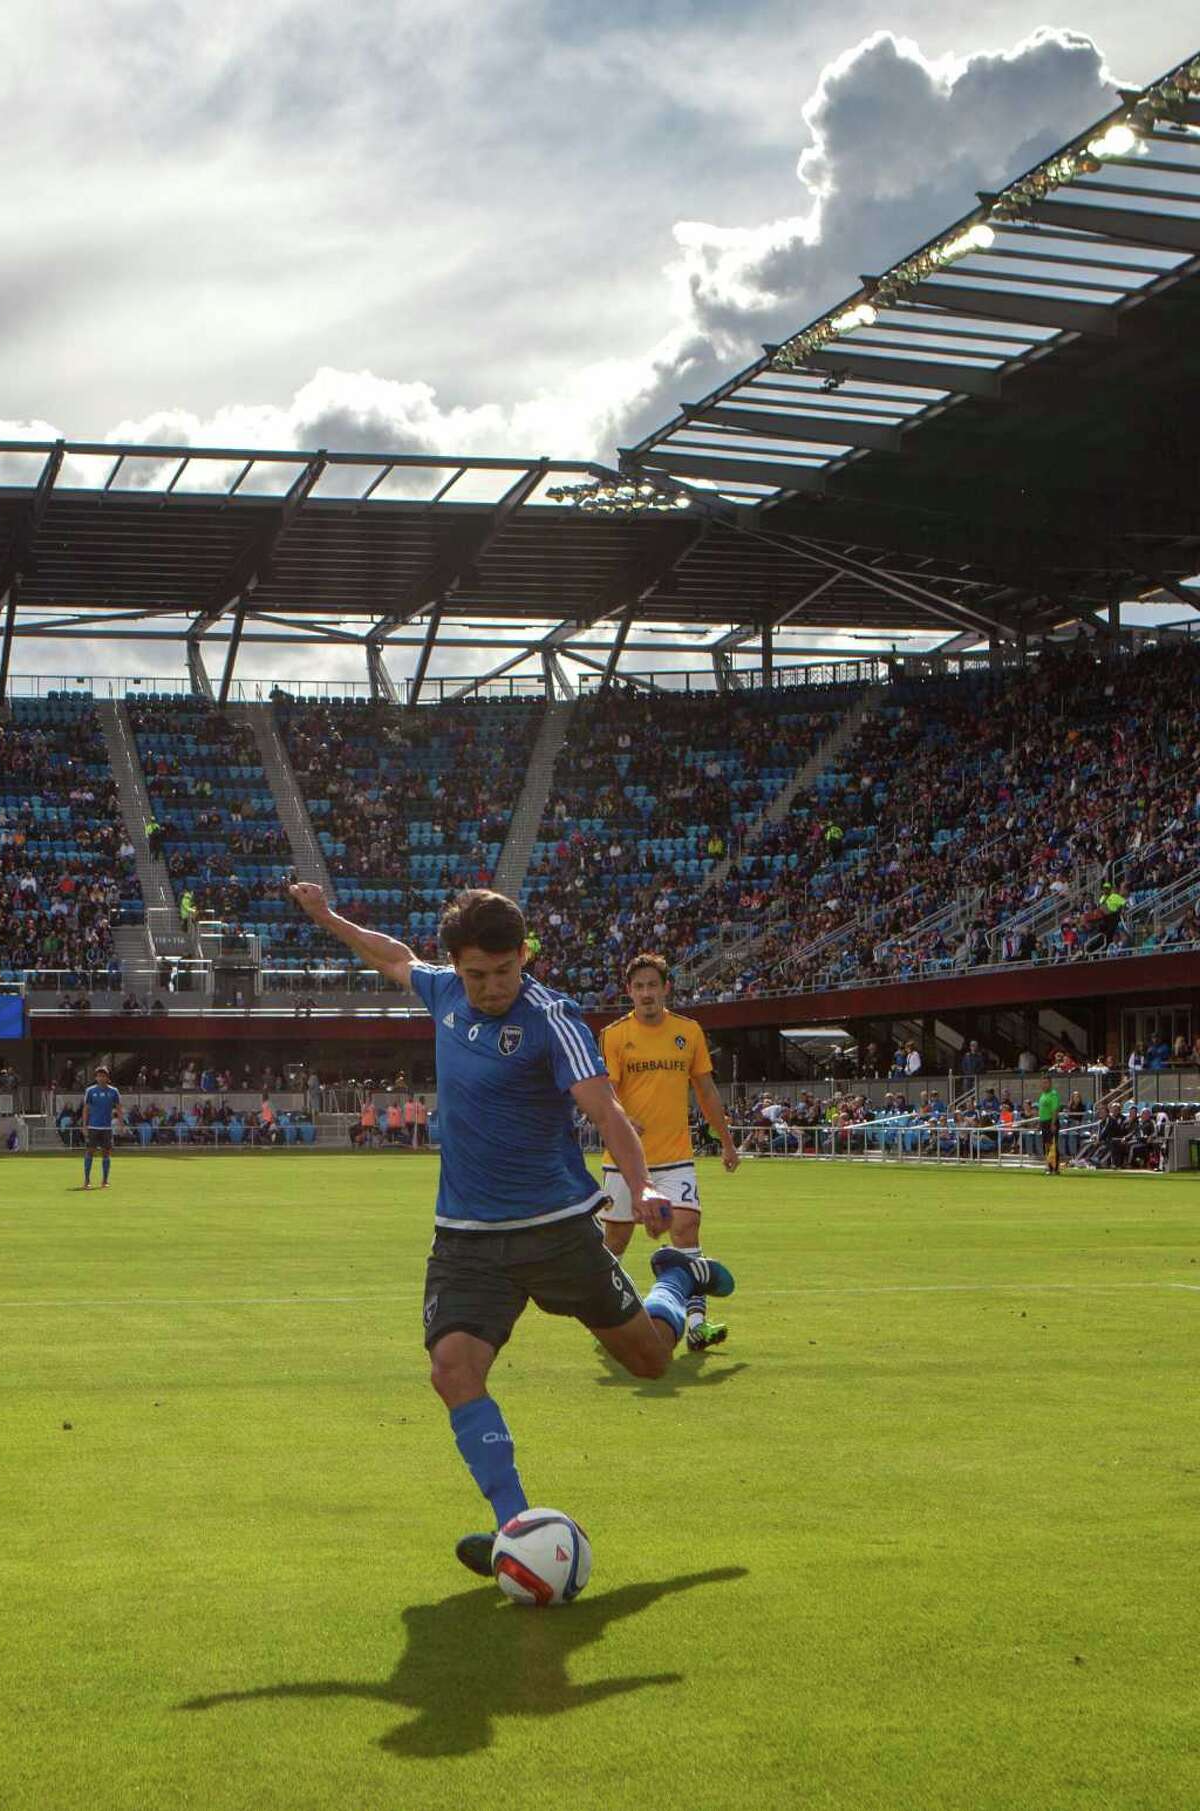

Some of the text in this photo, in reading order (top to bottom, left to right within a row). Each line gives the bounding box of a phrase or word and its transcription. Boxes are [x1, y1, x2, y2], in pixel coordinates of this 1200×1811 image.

[468, 1023, 483, 1042] 6
[627, 1060, 686, 1073] HERBALIFE
[611, 1270, 623, 1292] 6
